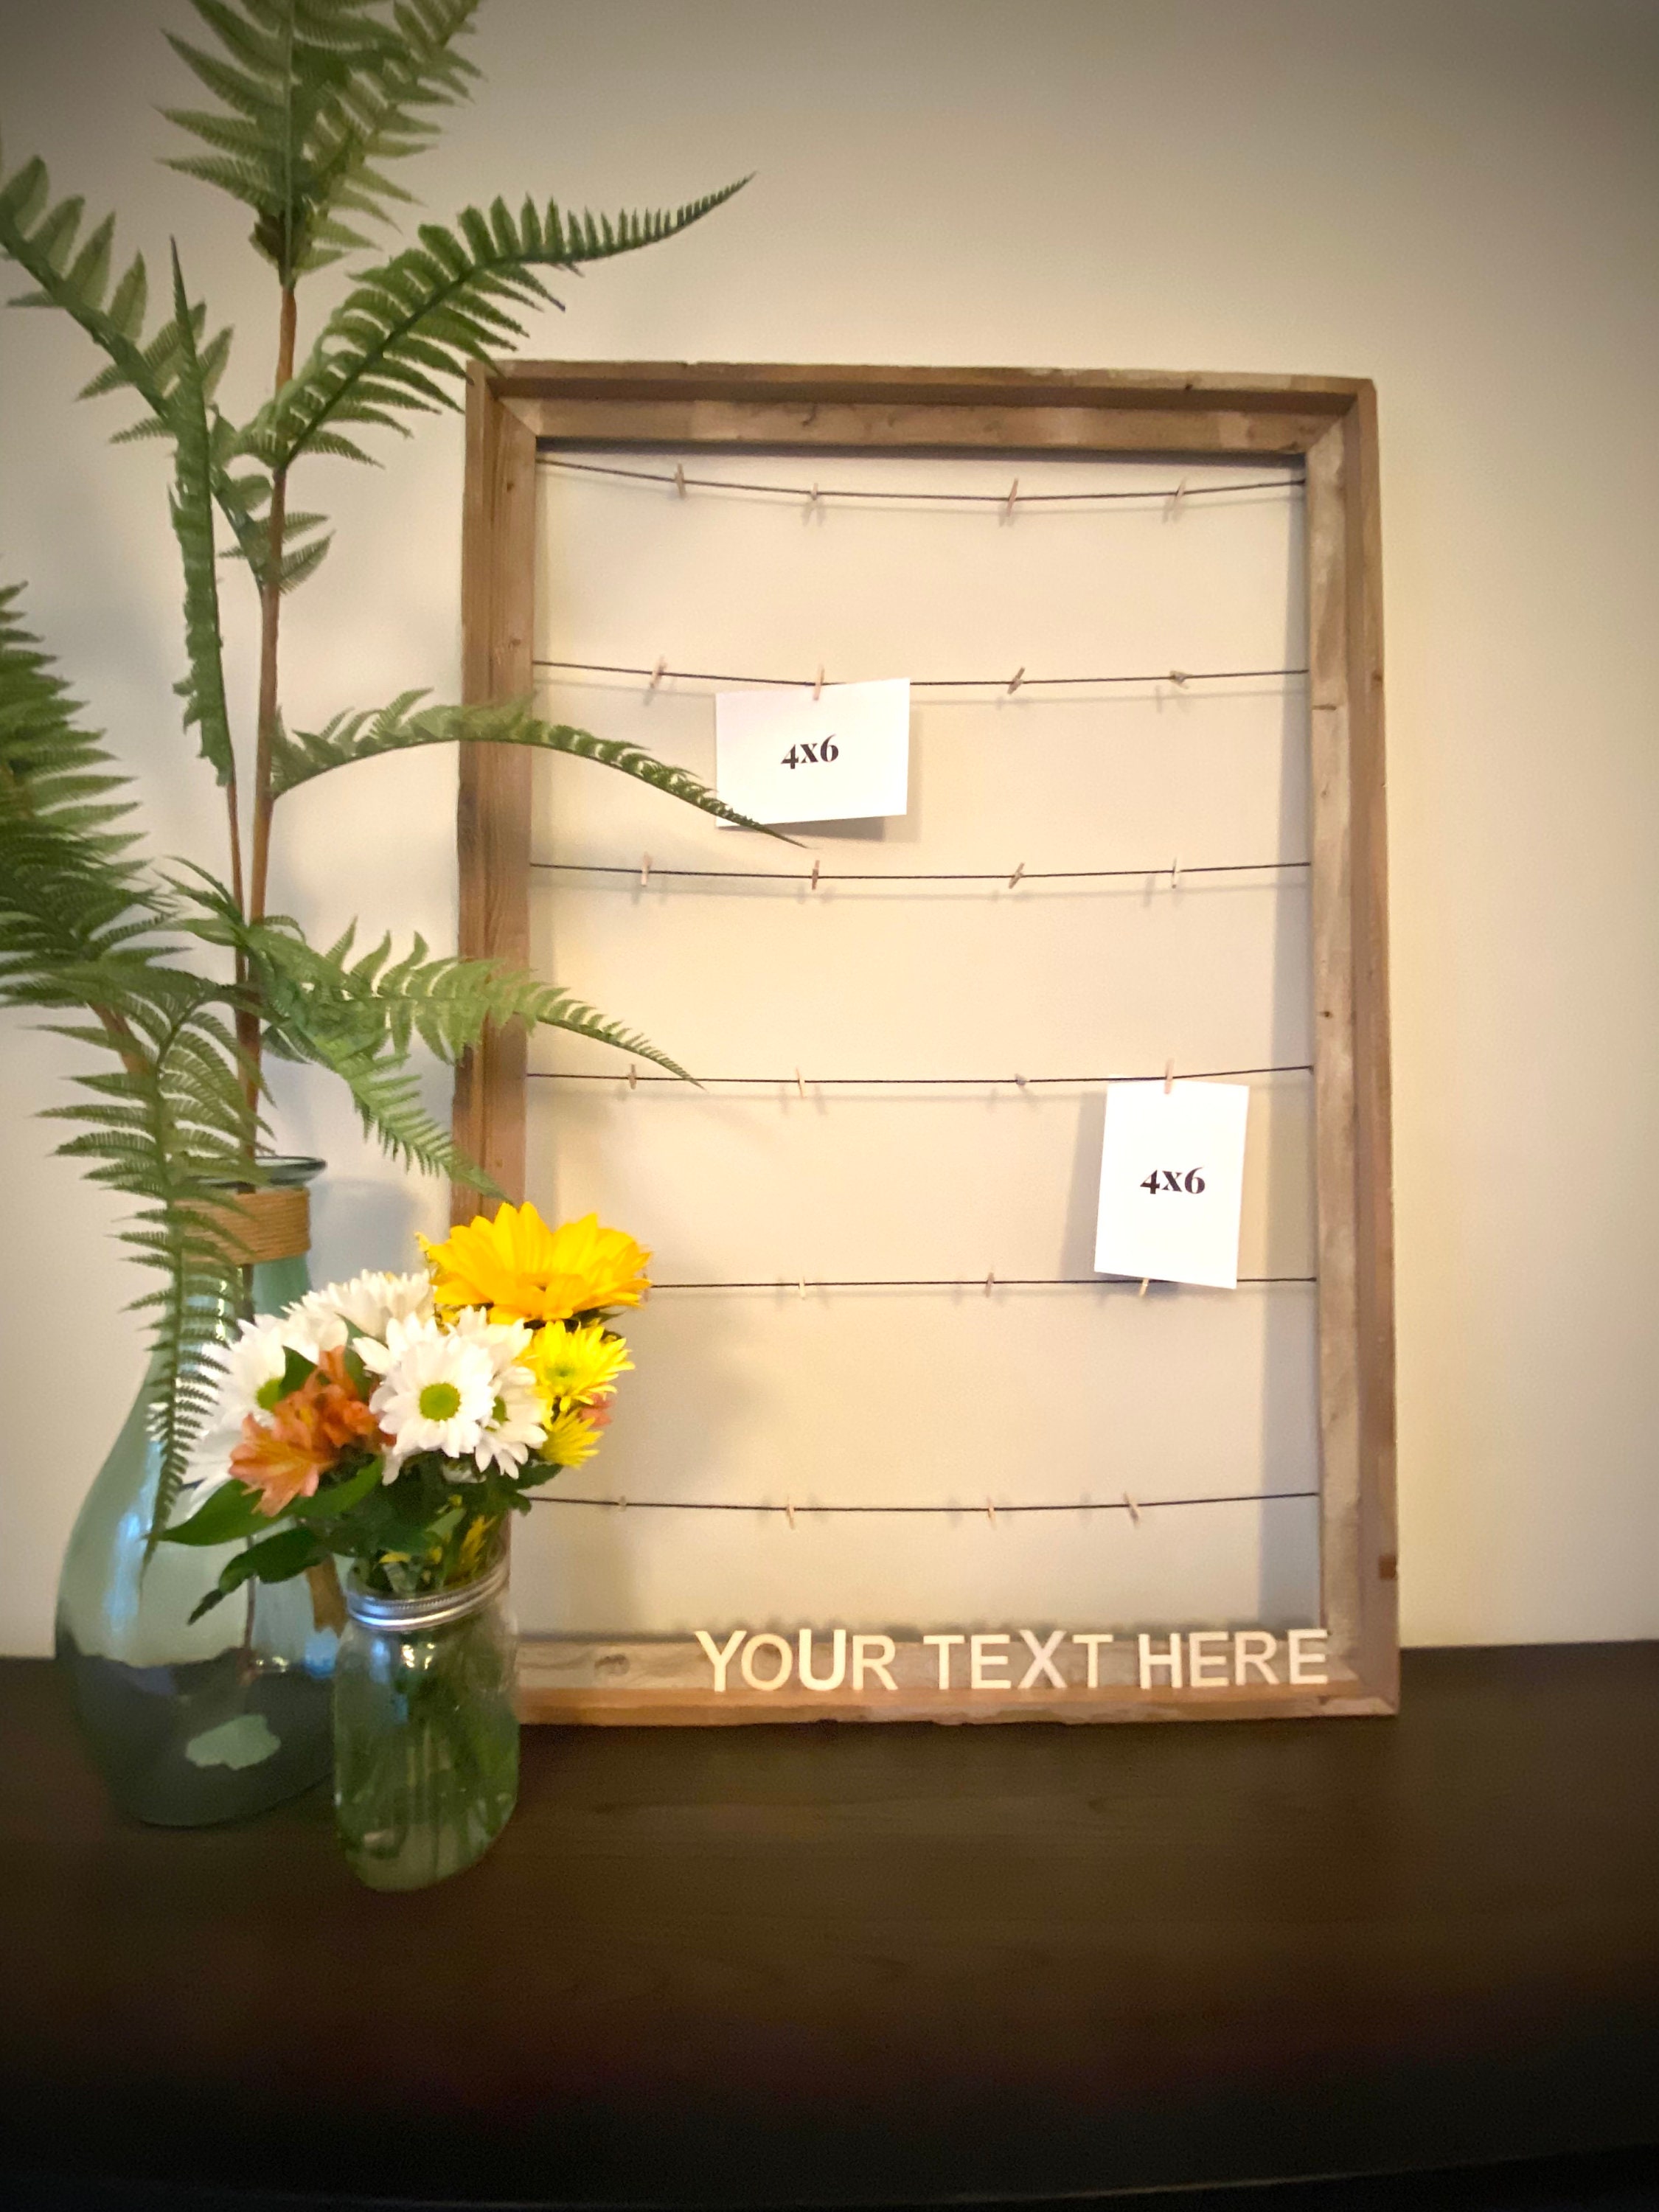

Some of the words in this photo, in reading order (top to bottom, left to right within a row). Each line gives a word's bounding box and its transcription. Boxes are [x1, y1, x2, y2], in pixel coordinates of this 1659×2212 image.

[695, 1628, 898, 1692] YOUR
[923, 1629, 1111, 1690] TEXT
[1138, 1628, 1329, 1690] HERE
